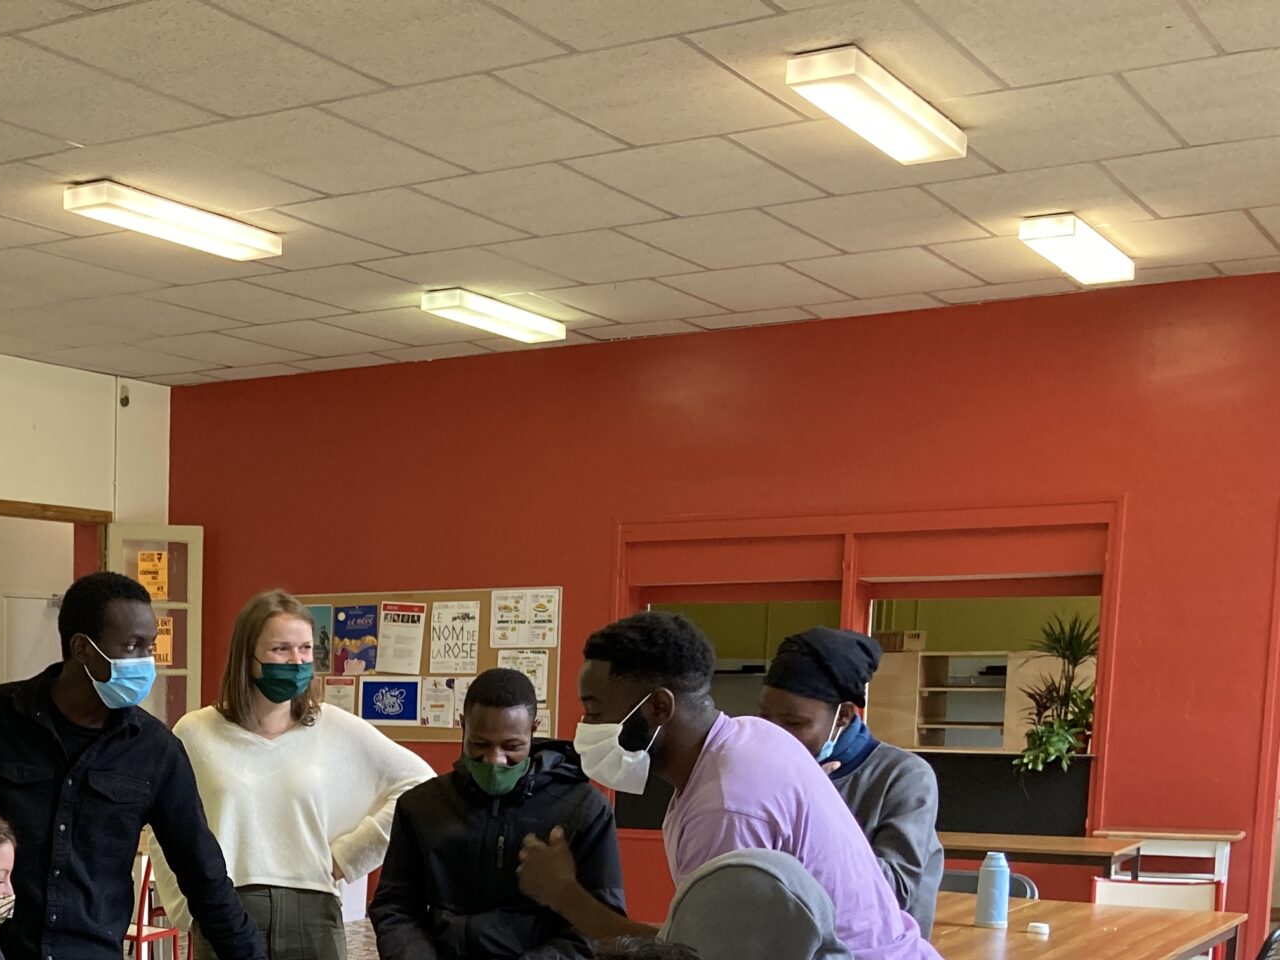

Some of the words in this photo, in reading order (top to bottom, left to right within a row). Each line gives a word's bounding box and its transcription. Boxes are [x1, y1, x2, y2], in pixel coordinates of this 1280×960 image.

[433, 612, 442, 623] LE
[432, 625, 464, 641] NOM
[467, 631, 477, 641] DE
[432, 649, 442, 659] LA
[444, 643, 476, 659] ROSE
